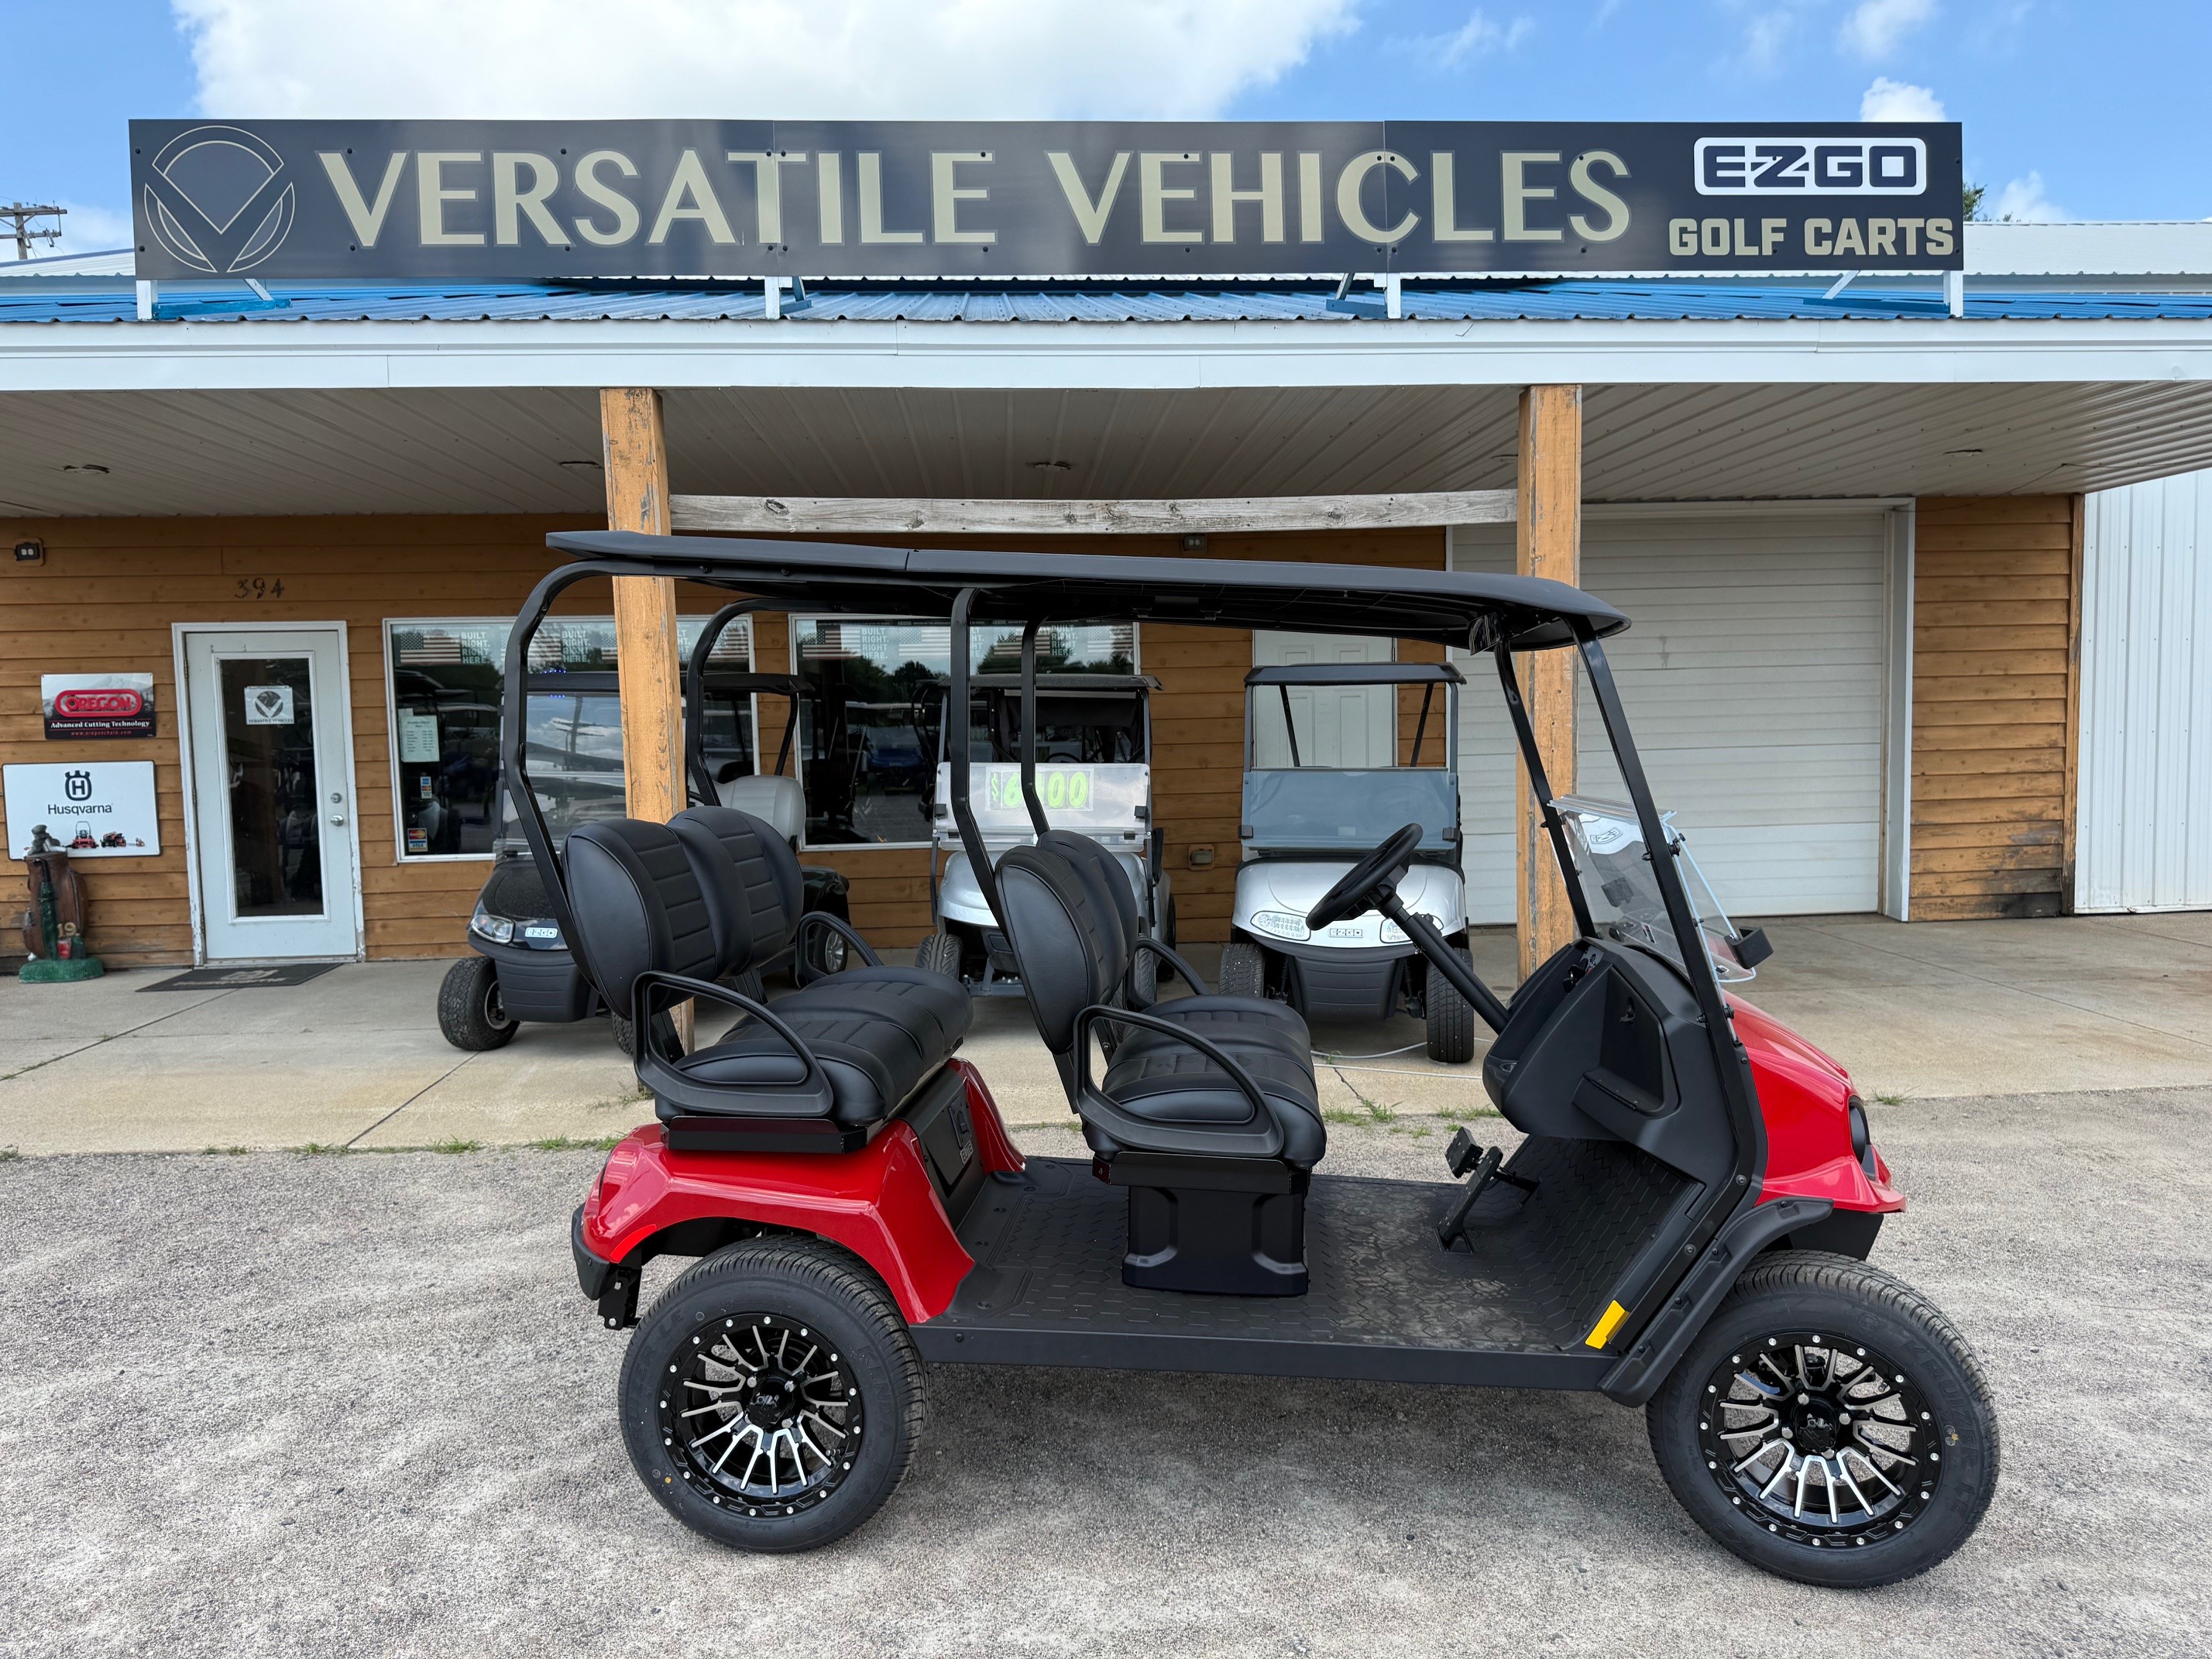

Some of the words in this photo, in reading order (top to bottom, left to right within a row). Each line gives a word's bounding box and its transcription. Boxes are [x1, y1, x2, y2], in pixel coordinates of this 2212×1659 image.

[1701, 143, 1920, 190] EZGO
[316, 149, 998, 247] VERSATILE
[1046, 149, 1632, 246] VEHICLES
[1668, 218, 1788, 256] GOLF
[1803, 218, 1954, 256] CARTS
[235, 577, 285, 599] 394
[1051, 624, 1074, 633] BUILT
[562, 638, 591, 647] RIGHT.
[861, 635, 889, 644] RIGHT.
[1051, 640, 1077, 648] RIGHT
[462, 647, 489, 656] RIGHT
[562, 647, 589, 655] RIGHT
[65, 696, 132, 711] OREGON
[111, 720, 150, 728] Technology
[47, 802, 112, 816] Husqvarna
[57, 922, 77, 938] 19
[526, 928, 557, 938] EZGO
